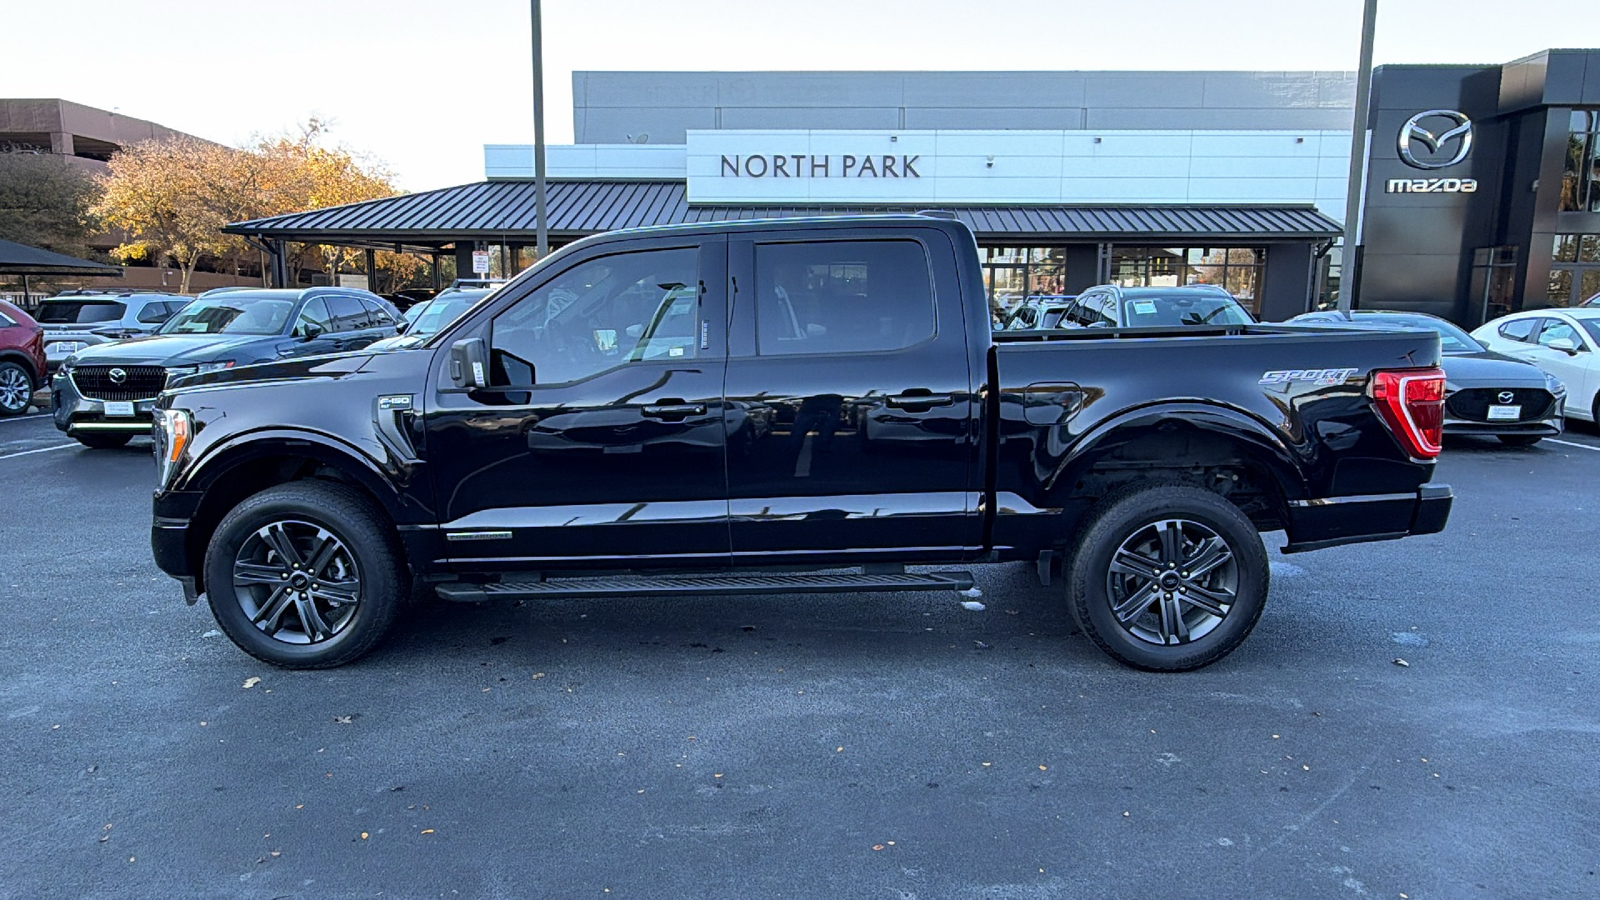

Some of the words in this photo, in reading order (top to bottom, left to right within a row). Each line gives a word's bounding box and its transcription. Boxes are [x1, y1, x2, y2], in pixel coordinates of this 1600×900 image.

[720, 154, 829, 178] NORTH
[842, 154, 921, 178] PARK
[1258, 368, 1359, 385] SPORT
